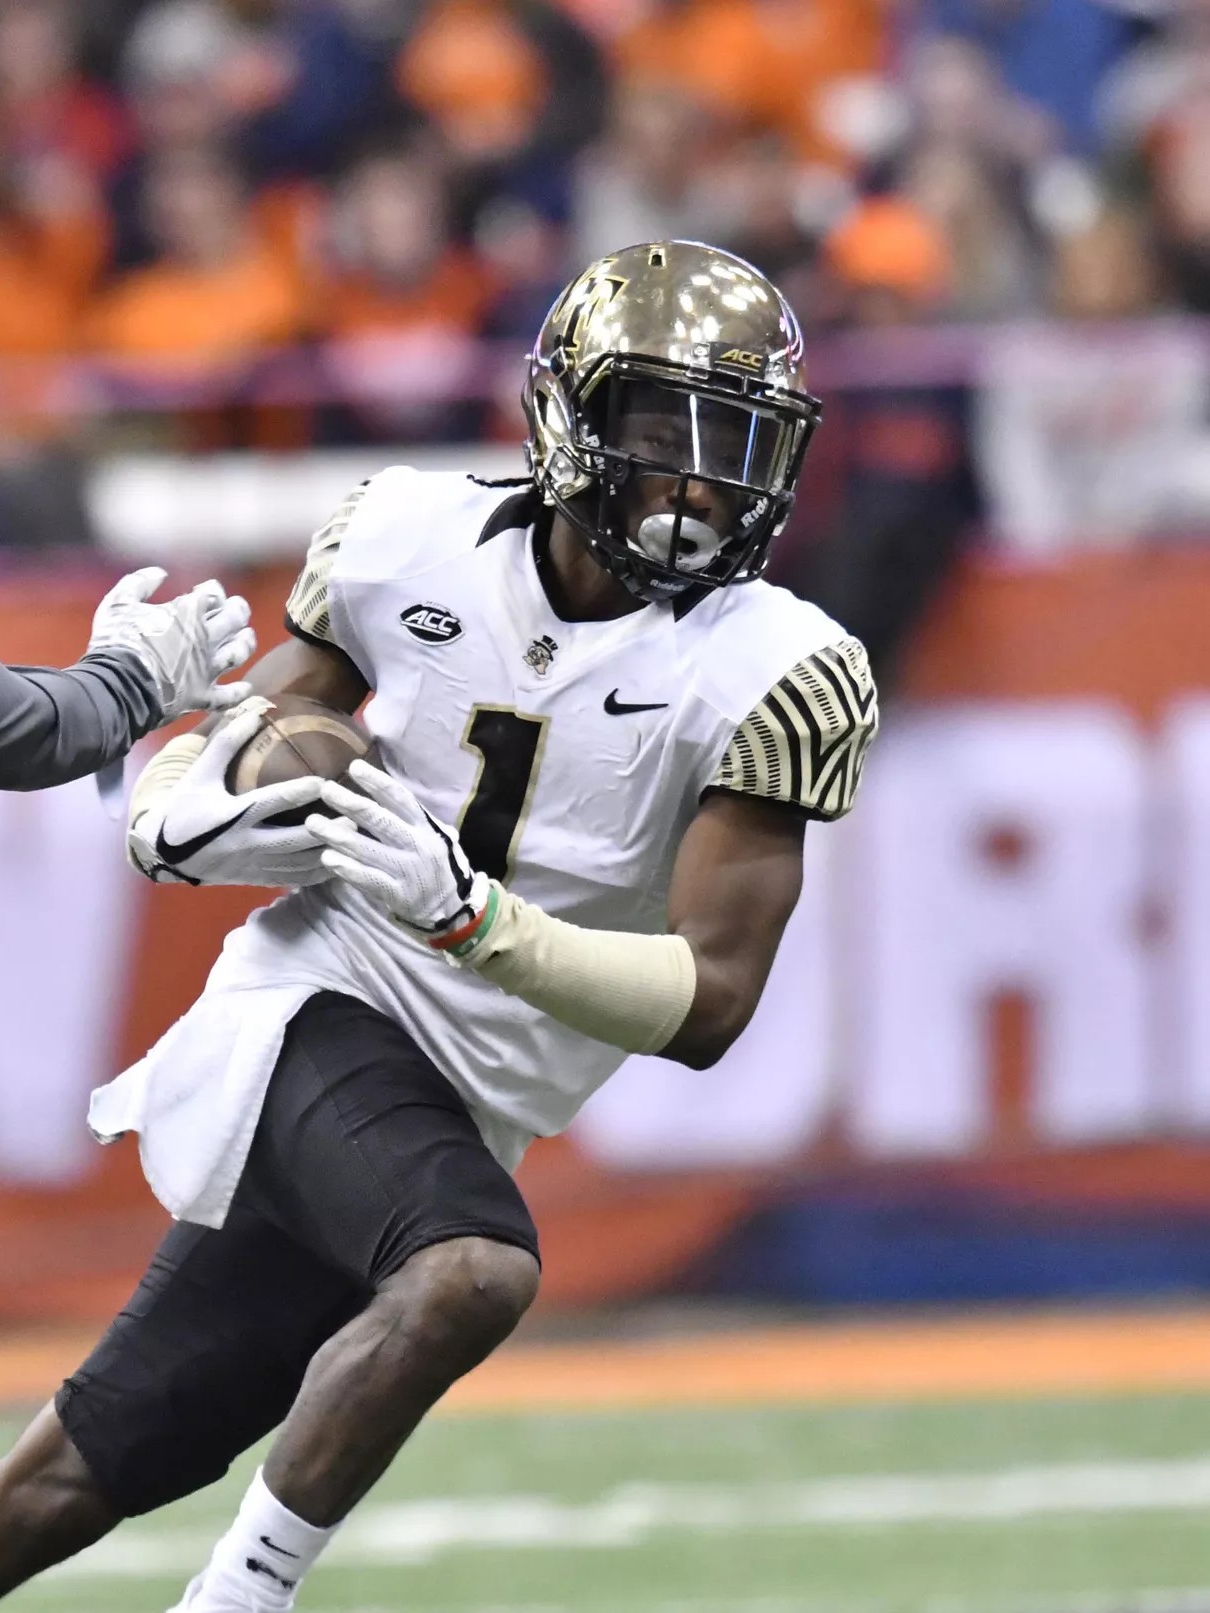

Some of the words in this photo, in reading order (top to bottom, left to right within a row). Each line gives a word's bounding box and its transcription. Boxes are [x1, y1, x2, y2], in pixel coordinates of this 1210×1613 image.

[720, 348, 763, 368] ACC
[404, 609, 458, 634] ACC
[454, 702, 552, 892] 1
